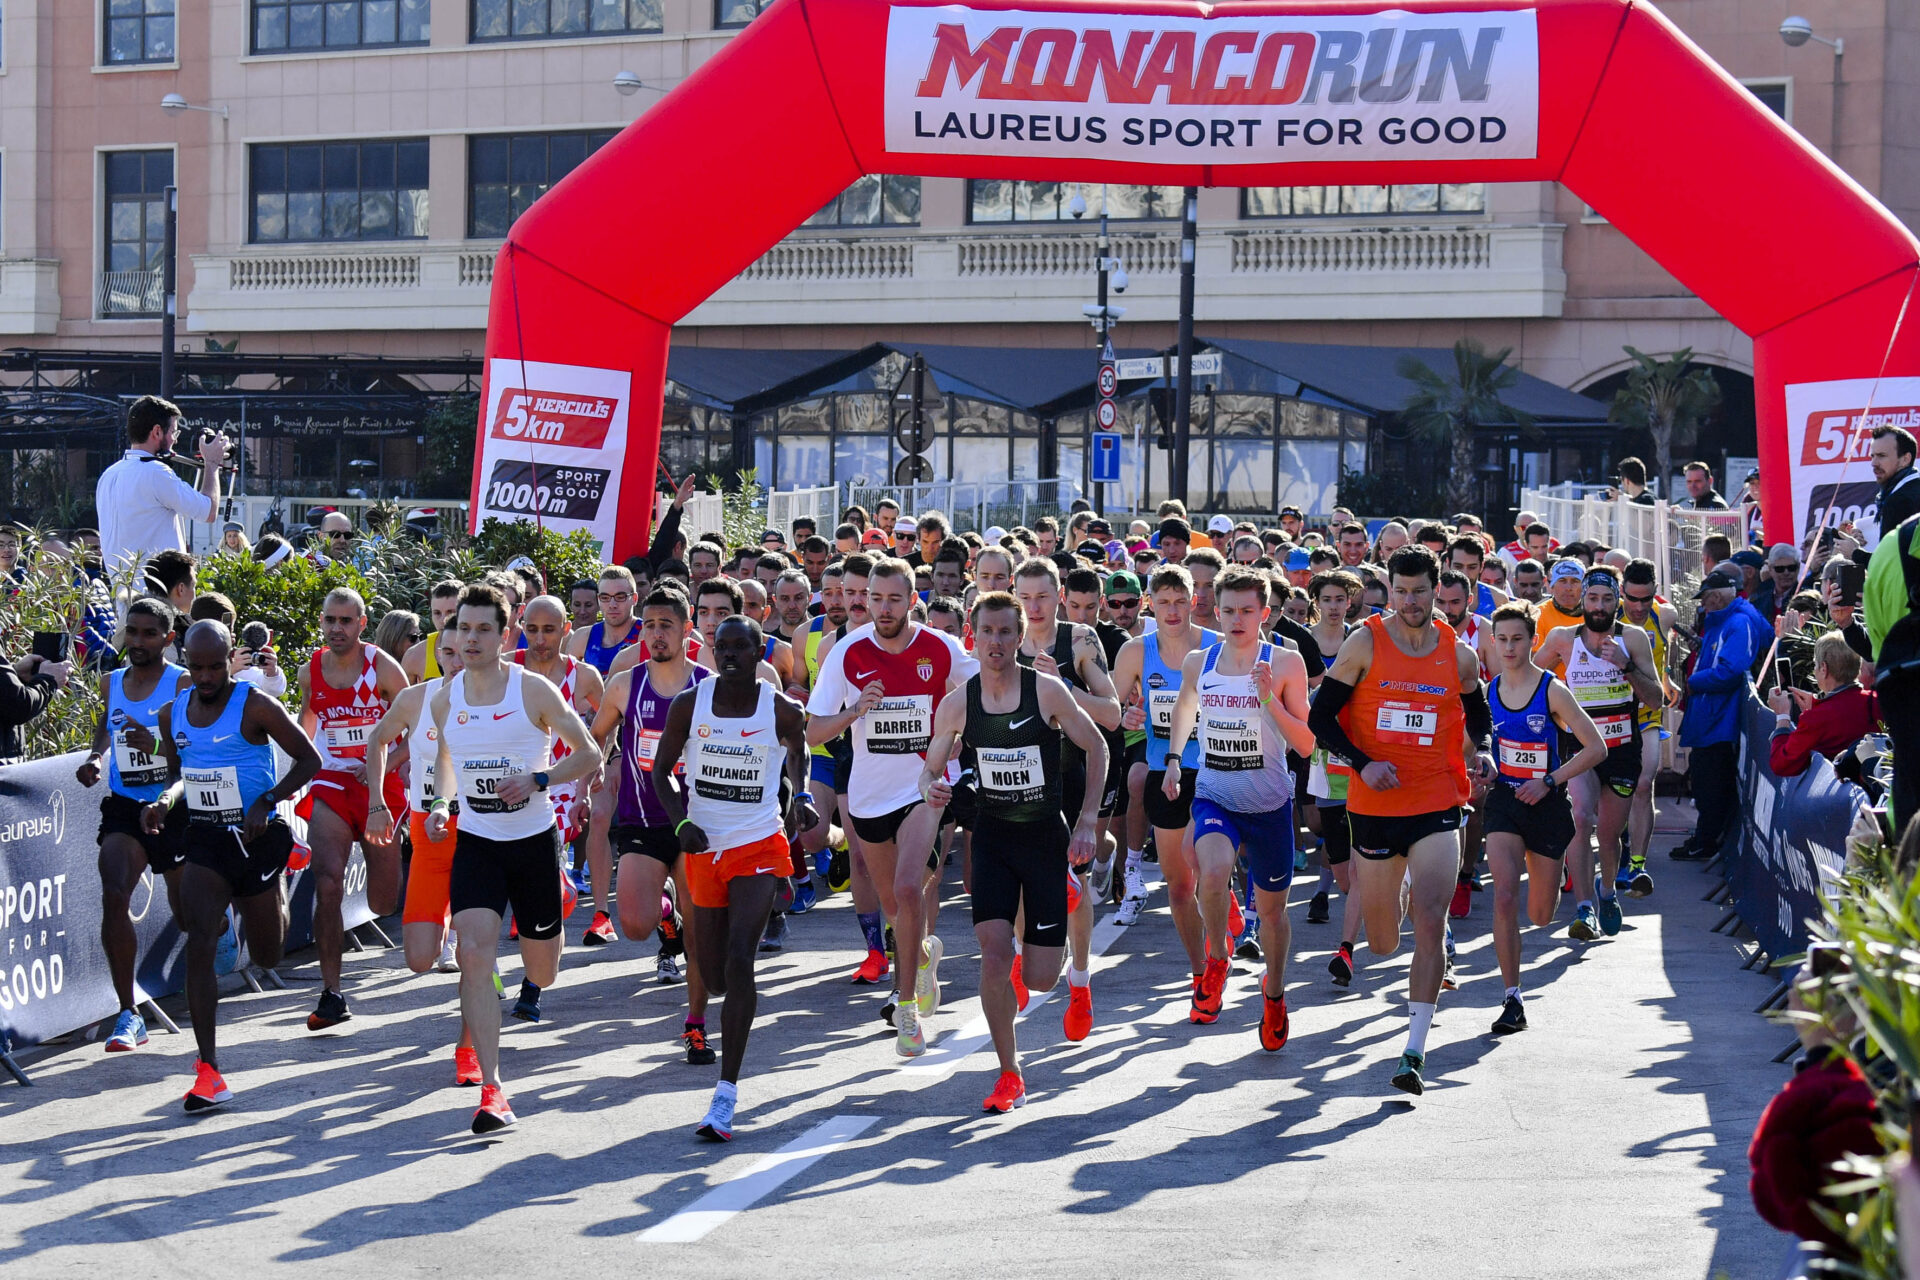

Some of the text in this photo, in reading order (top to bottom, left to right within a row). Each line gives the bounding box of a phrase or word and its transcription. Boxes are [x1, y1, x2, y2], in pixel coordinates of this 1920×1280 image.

[913, 111, 1507, 148] LAUREUS SPORT FOR GOOD
[1191, 359, 1211, 371] SINO
[1102, 374, 1114, 388] 30
[556, 470, 602, 484] SPORT
[554, 486, 600, 500] GOOD
[1571, 670, 1604, 681] gruppo
[642, 700, 655, 712] APA
[870, 699, 916, 711] ERCULIS
[1153, 695, 1177, 704] HERC
[1201, 694, 1261, 709] GREAT BRITAIN
[327, 706, 380, 719] MONACO
[909, 707, 927, 717] EBS
[874, 719, 922, 735] BARRER
[1405, 714, 1424, 728] 113
[347, 729, 363, 741] 111
[1240, 728, 1258, 738] EBS
[1604, 724, 1623, 735] 246
[1206, 737, 1258, 753] TRAYNOR
[744, 755, 764, 765] EBS
[1020, 757, 1038, 768] EBS
[1515, 751, 1537, 764] 235
[503, 766, 523, 776] EBS
[701, 764, 760, 781] KIPLANGAT
[216, 780, 234, 789] EBS
[991, 770, 1031, 786] MOEN
[200, 791, 219, 807] ALI
[0, 816, 52, 843] aureus
[0, 953, 63, 1010] GOOD
